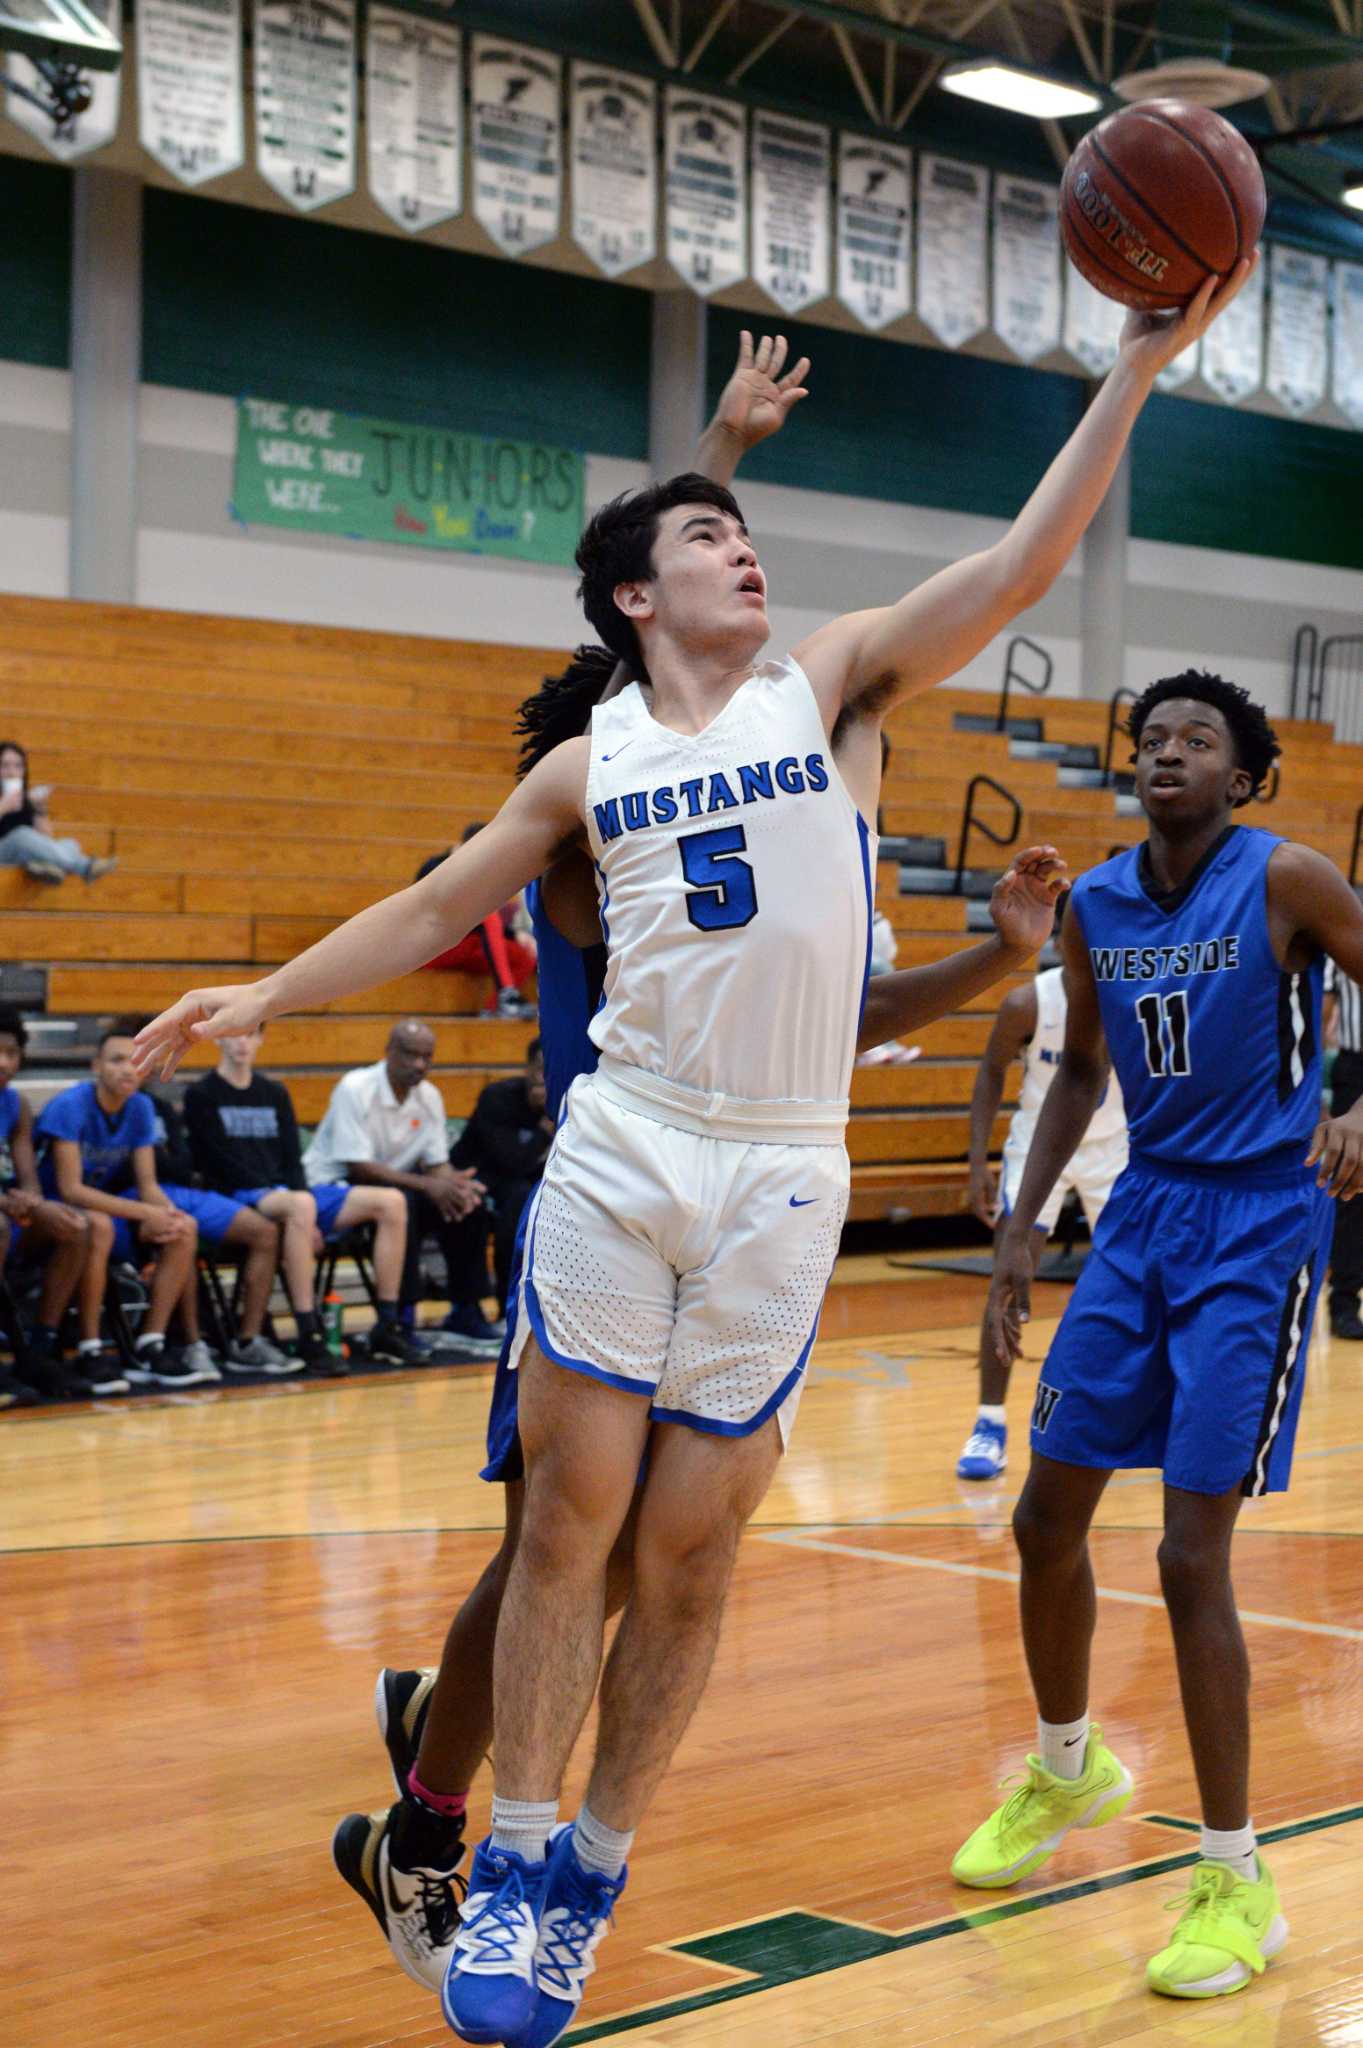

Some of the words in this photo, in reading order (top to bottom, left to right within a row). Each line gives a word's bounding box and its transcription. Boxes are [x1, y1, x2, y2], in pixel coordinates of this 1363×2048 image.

[371, 431, 577, 513] JUNIORS
[593, 754, 829, 844] MUSTANGS
[677, 824, 758, 931] 5
[1090, 935, 1239, 981] WESTSIDE
[1135, 990, 1191, 1078] 11
